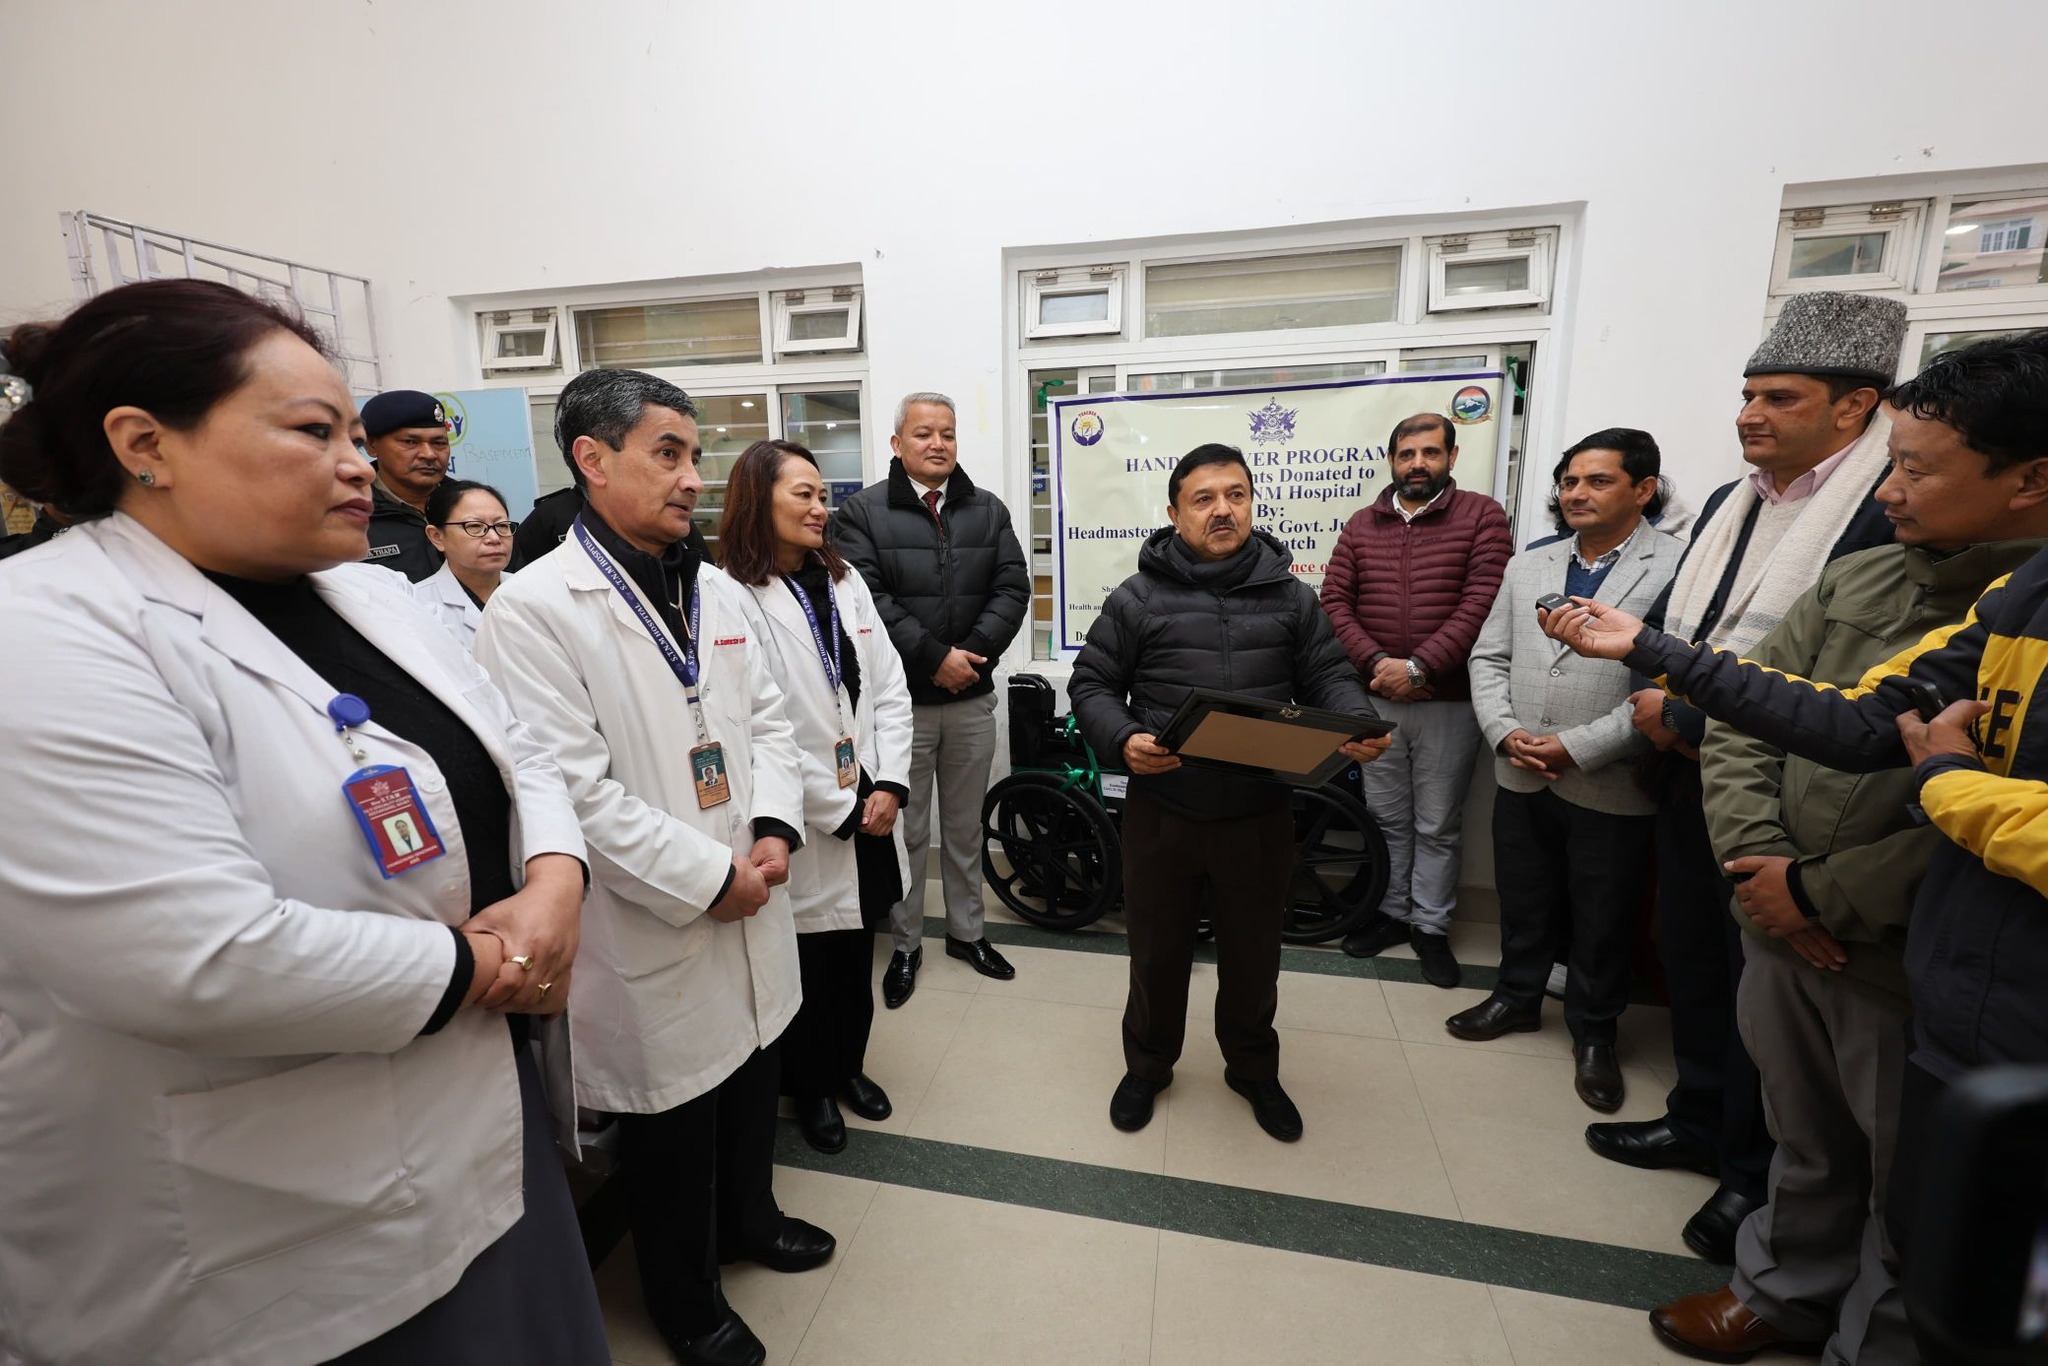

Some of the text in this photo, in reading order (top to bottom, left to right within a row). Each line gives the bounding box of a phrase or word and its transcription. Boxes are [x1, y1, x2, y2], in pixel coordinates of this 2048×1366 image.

[1126, 456, 1180, 473] HAND
[1280, 465, 1352, 483] Donated
[1359, 466, 1375, 480] to
[1253, 483, 1361, 503] NM Hospital
[1257, 504, 1285, 521] By:
[1279, 519, 1324, 534] Govt.
[1329, 518, 1348, 533] Ju
[1281, 536, 1316, 550] atch
[582, 536, 627, 591] S.T.N.M HOSPITAL
[1291, 563, 1315, 573] nce
[1069, 603, 1092, 611] Health
[633, 602, 678, 662] S.T.N.M HOSPITAL
[690, 607, 699, 640] HOSPITAL
[811, 624, 826, 657] HOSPITAL
[1075, 631, 1087, 642] Da
